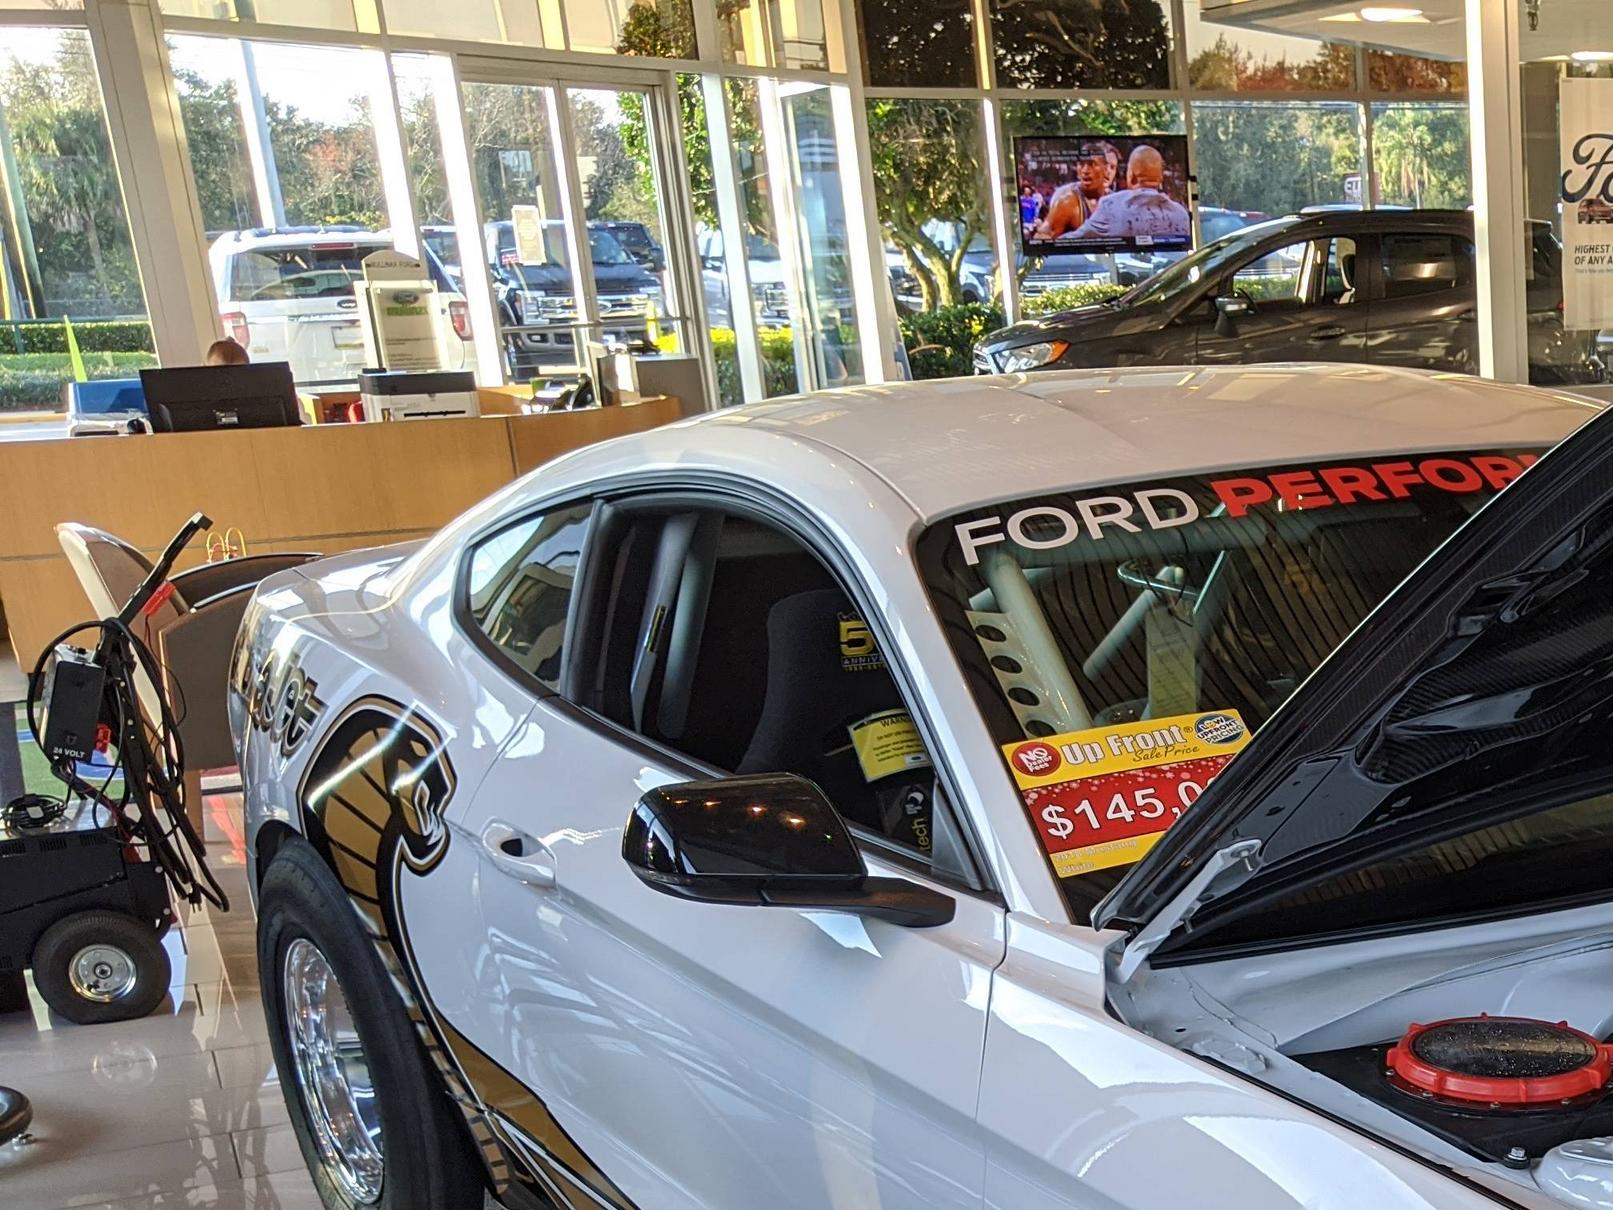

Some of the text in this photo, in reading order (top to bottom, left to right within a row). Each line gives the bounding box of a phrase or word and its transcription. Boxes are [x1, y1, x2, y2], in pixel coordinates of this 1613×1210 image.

[1574, 244, 1610, 254] HIGHEST
[1574, 256, 1586, 265] OF
[1587, 256, 1606, 265] ANY
[954, 487, 1200, 566] FORD
[839, 619, 875, 657] 5
[842, 655, 885, 667] ANNIV
[1197, 719, 1238, 739] UPFRONT
[1205, 724, 1244, 744] PRICING
[64, 748, 86, 758] VOLT
[1060, 724, 1187, 766] Up Front
[1132, 744, 1200, 763] Sale Price
[1018, 748, 1048, 766] NO
[1027, 755, 1052, 768] Dealer
[1041, 777, 1214, 840] $145,0
